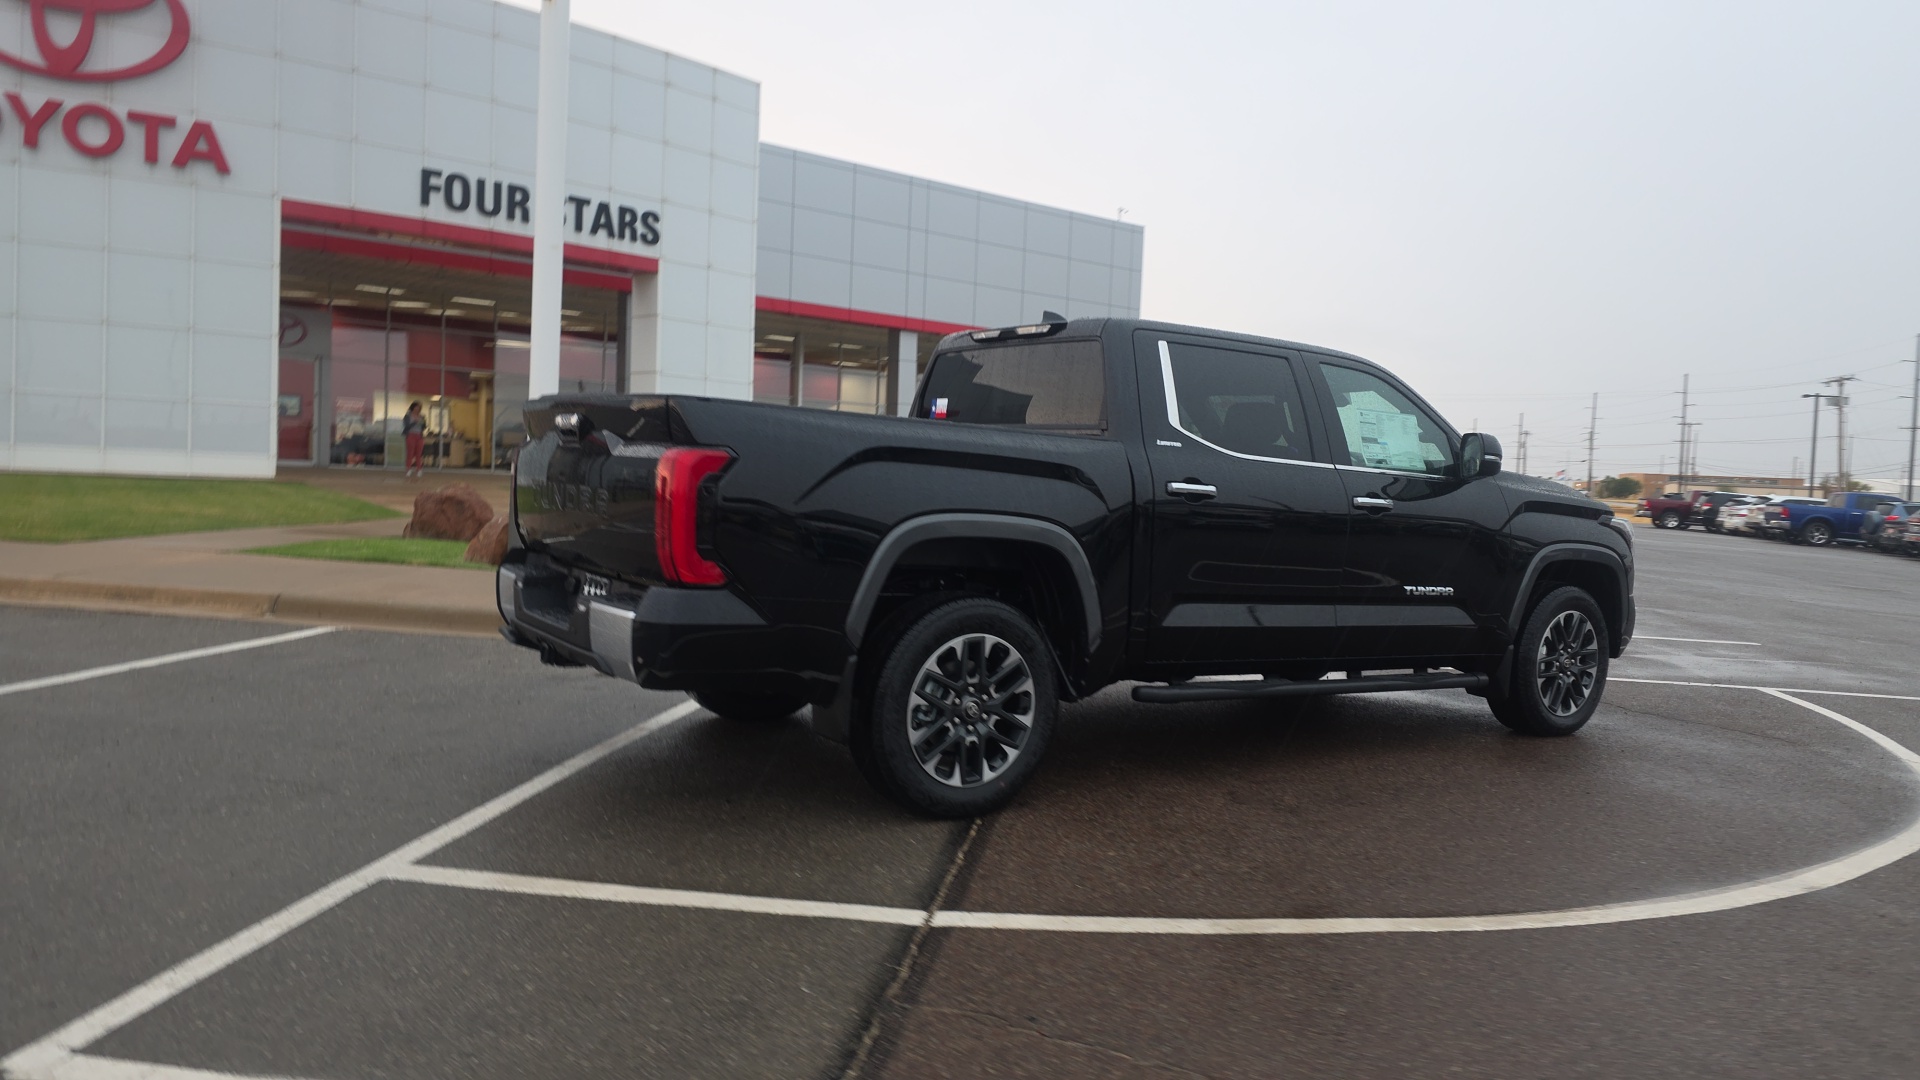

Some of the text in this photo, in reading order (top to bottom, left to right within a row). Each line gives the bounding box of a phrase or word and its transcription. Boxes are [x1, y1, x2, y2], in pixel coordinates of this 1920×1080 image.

[0, 91, 231, 175] YOTA
[421, 167, 660, 246] FOUR TARS
[1403, 585, 1454, 596] TUNDRA
